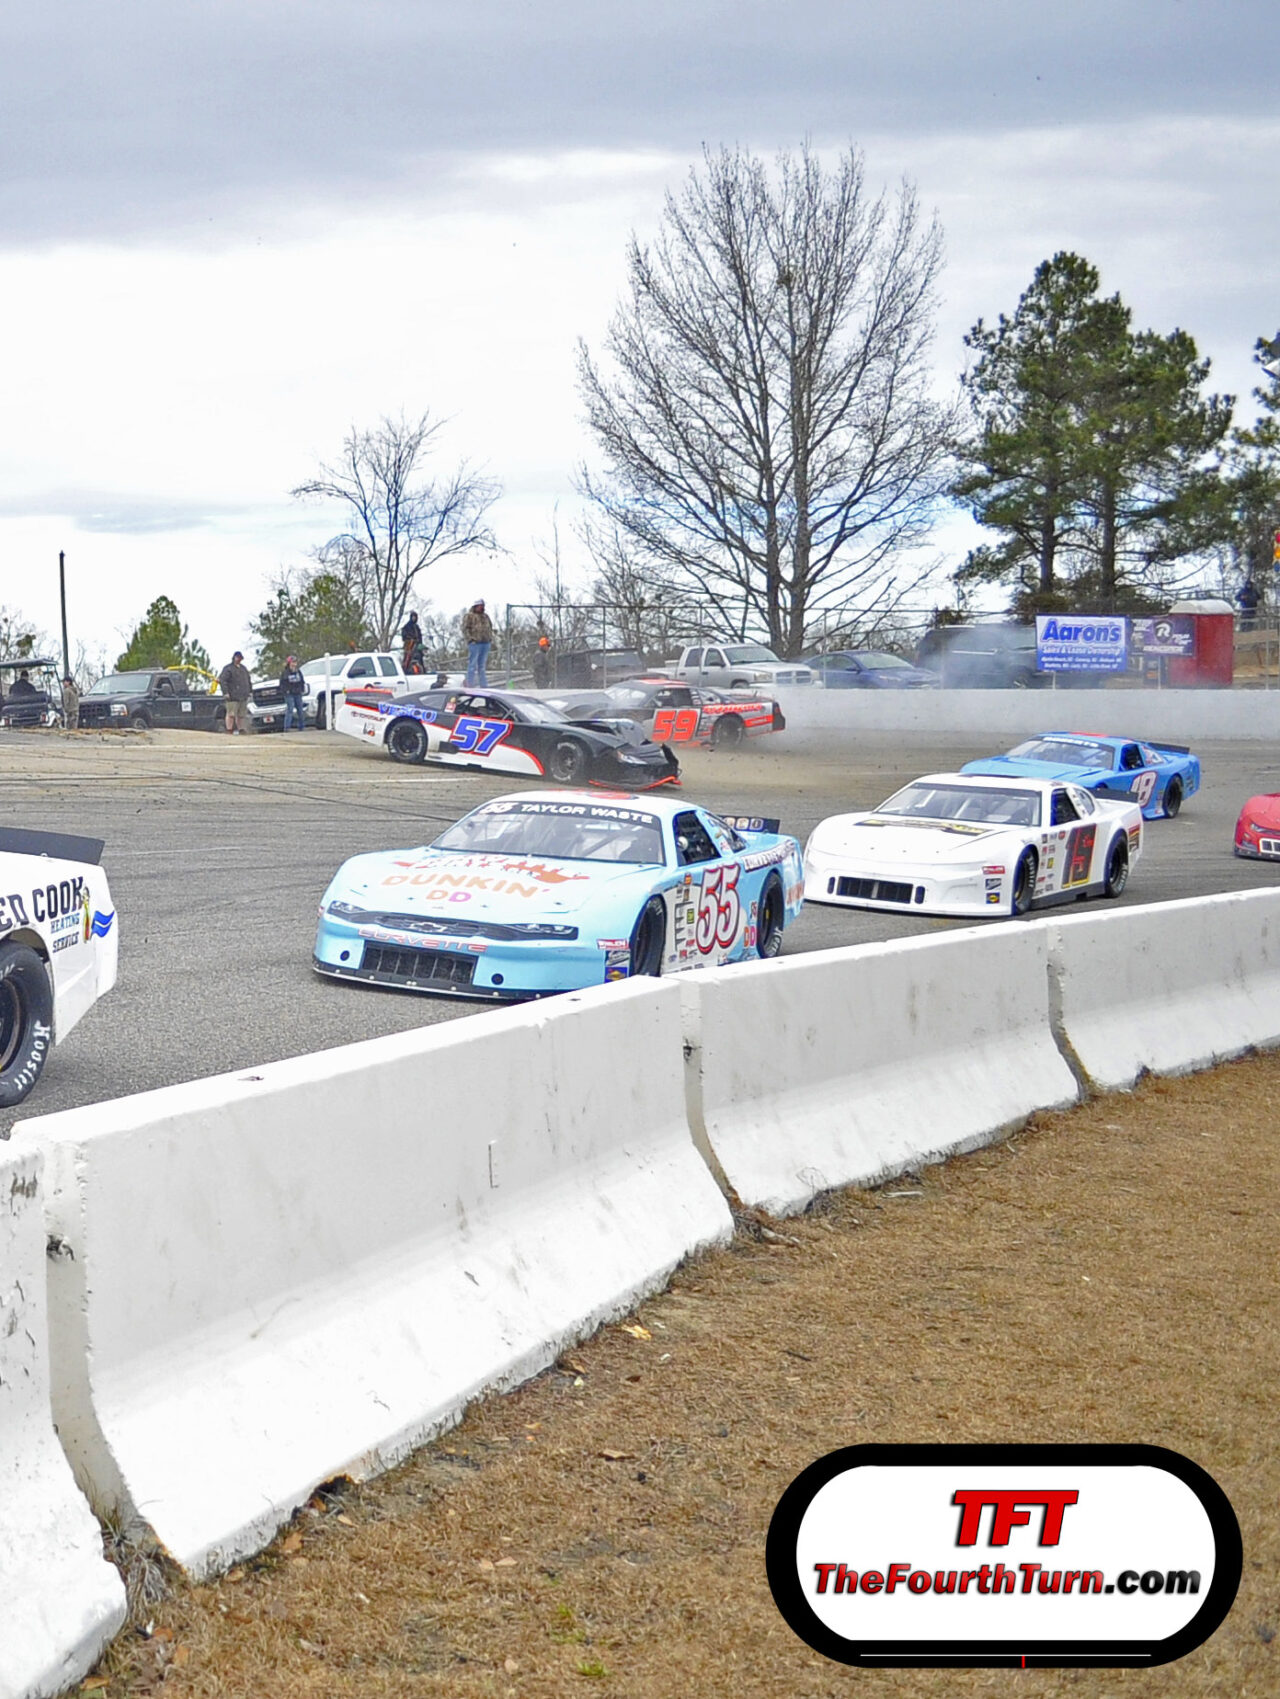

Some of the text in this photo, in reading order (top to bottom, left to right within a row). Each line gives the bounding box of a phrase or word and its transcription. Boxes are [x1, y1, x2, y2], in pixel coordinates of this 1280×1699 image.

[1041, 618, 1122, 642] Aaron's
[377, 701, 437, 723] VESCO
[652, 709, 698, 742] 59
[450, 716, 510, 755] 57
[521, 803, 586, 816] TAYLOR
[591, 807, 653, 824] WASTE
[32, 876, 84, 923] COOK
[696, 861, 741, 955] 55
[358, 928, 488, 953] CORVETTE
